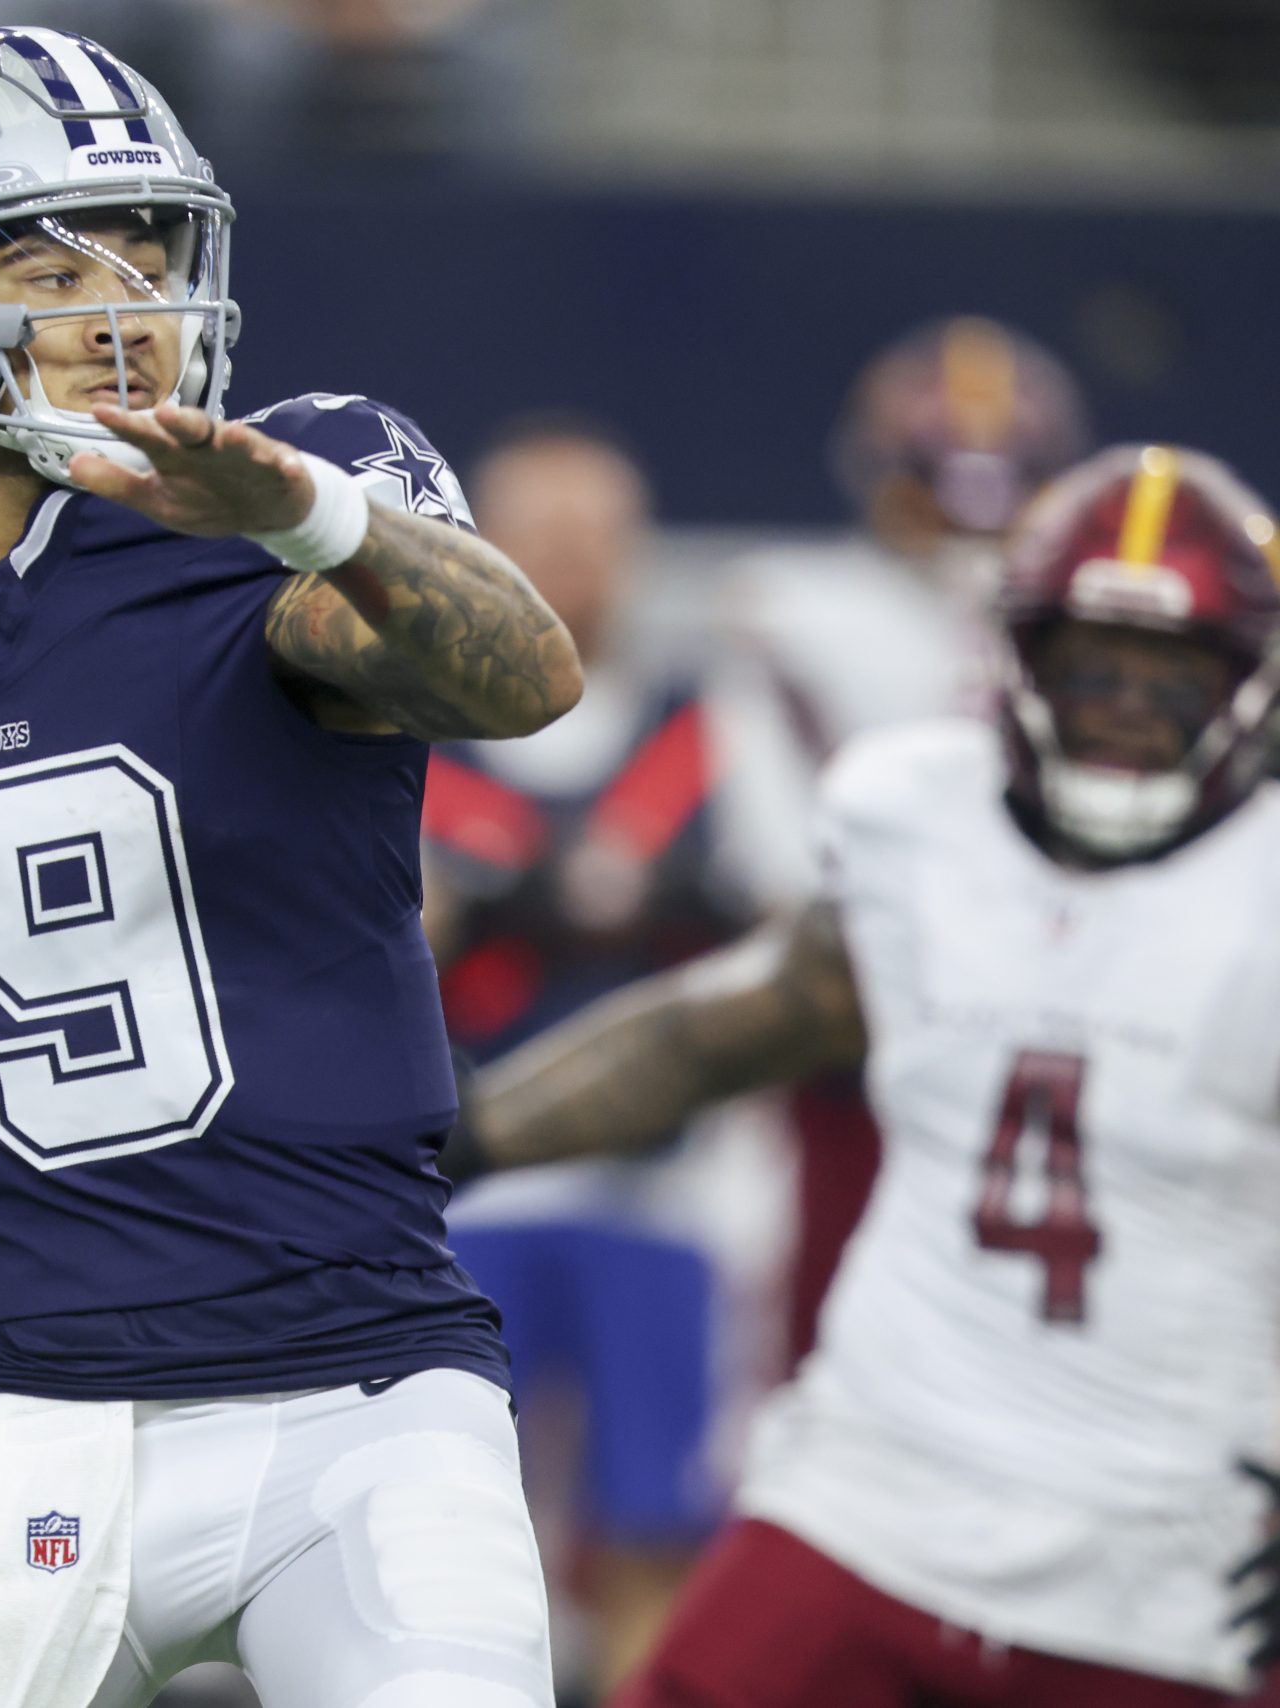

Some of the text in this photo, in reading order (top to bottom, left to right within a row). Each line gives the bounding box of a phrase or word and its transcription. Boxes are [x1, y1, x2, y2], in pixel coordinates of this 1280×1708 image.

[86, 149, 163, 165] COWBOYS
[971, 1049, 1102, 1326] 4
[32, 1538, 76, 1567] NFL
